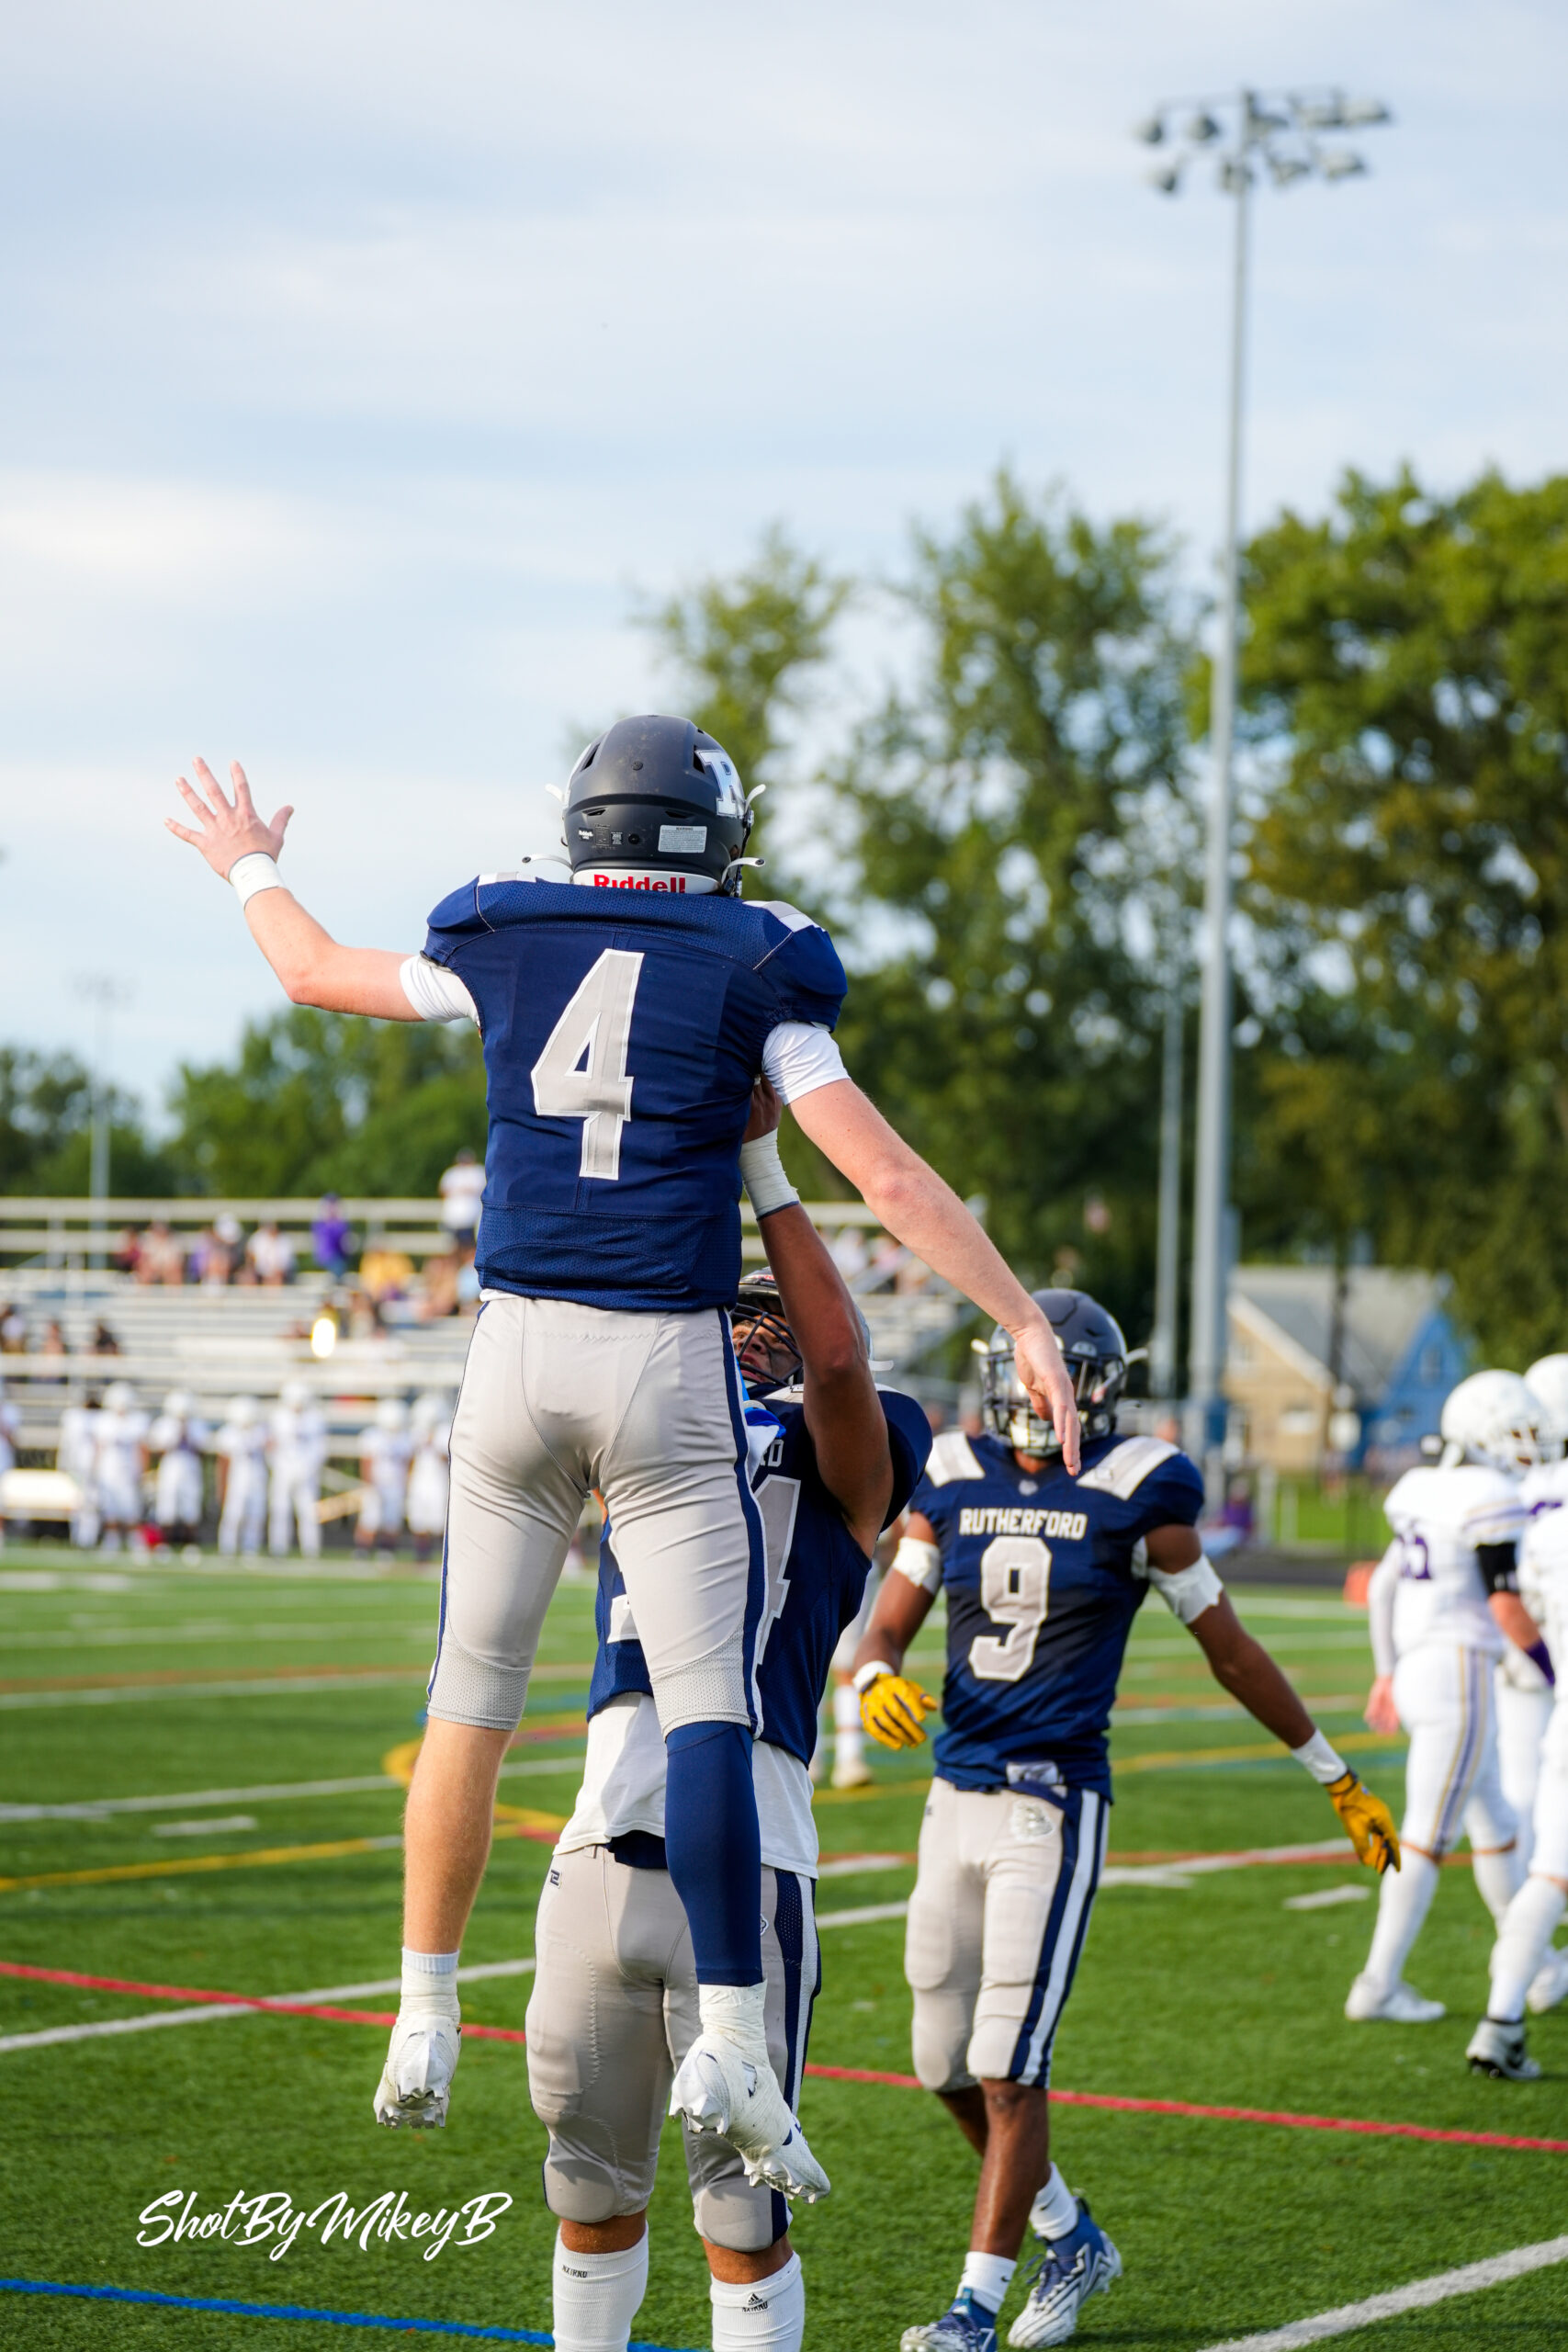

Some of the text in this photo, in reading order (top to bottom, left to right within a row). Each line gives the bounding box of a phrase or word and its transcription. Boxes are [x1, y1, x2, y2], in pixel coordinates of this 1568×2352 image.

[594, 875, 685, 894] Riddell
[530, 948, 645, 1181] 4
[959, 1508, 1088, 1540] RUTHERFORD
[968, 1535, 1053, 1681] 9
